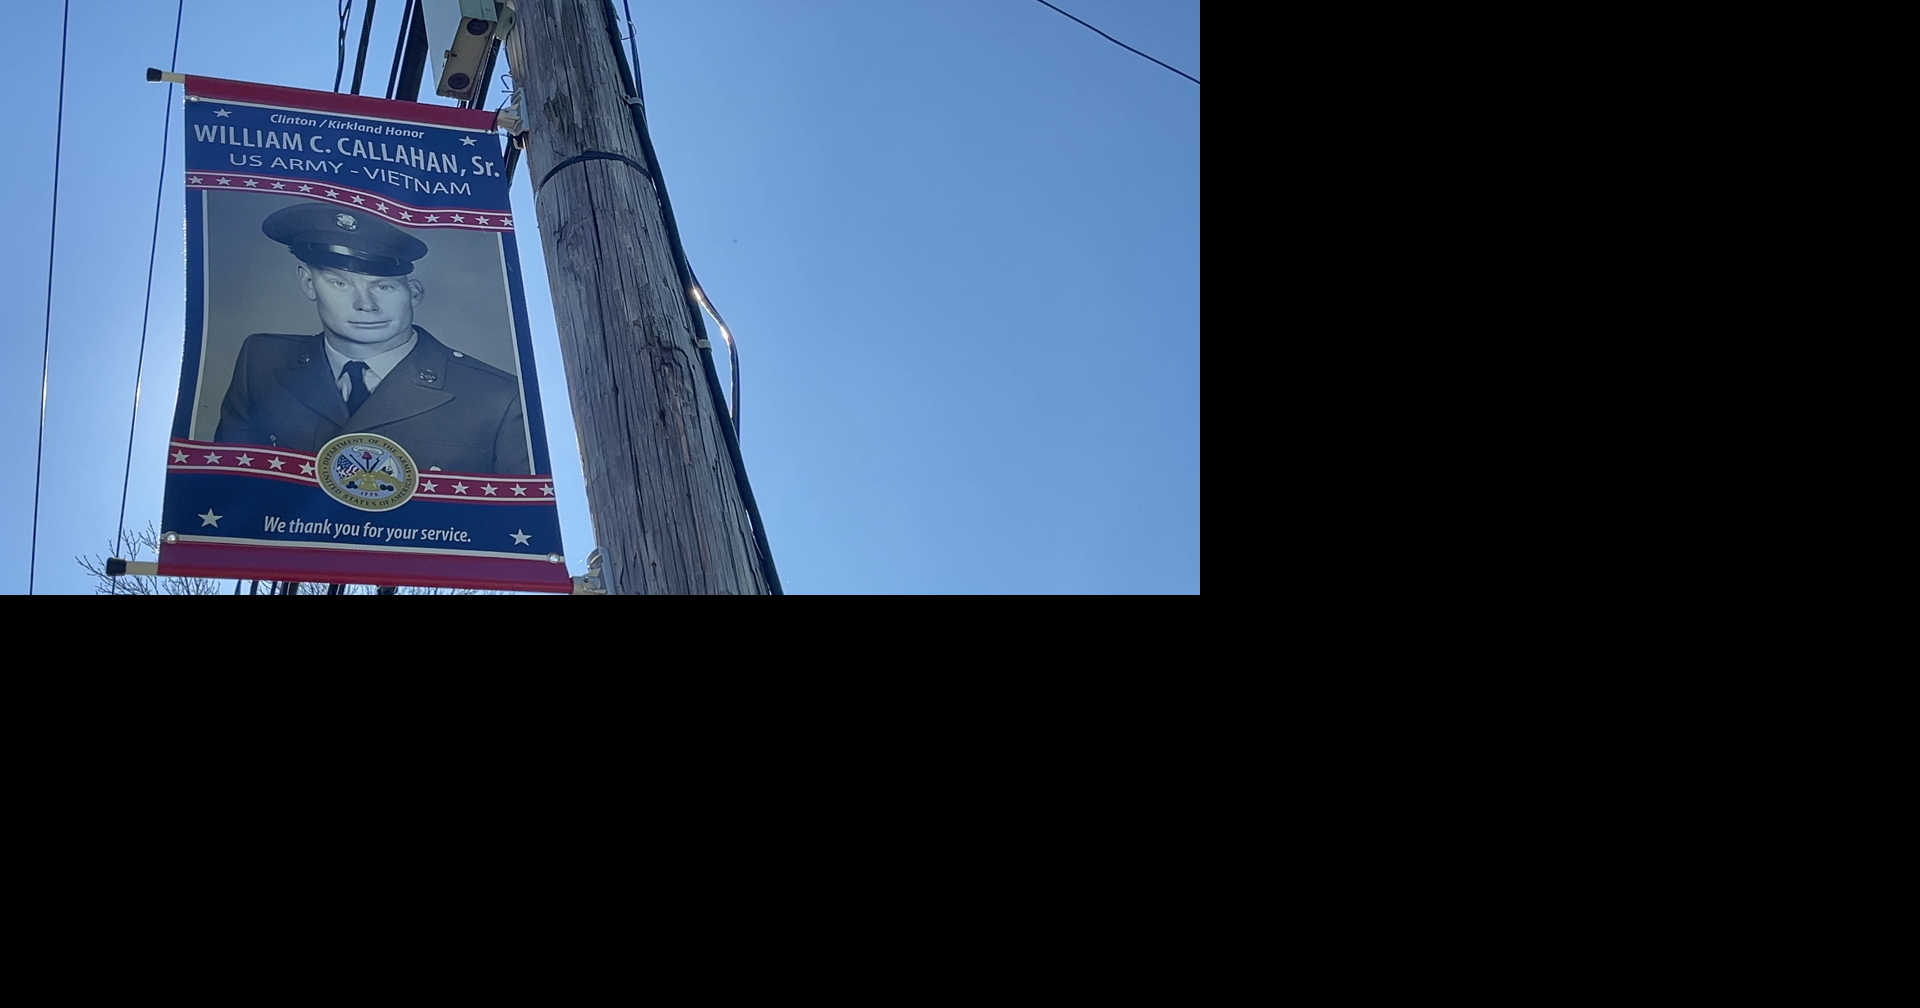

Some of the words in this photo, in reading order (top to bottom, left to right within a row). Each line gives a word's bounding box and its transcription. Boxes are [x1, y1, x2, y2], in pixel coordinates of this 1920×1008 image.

[270, 114, 316, 127] Clinton
[385, 126, 425, 139] Honor
[194, 124, 303, 152] WILLIAM
[309, 135, 332, 154] C.
[337, 137, 467, 177] CALLAHAN,
[471, 155, 500, 178] Sr.
[229, 153, 263, 167] US
[270, 157, 344, 174] ARMY
[363, 166, 472, 196] VIETNAM
[323, 438, 364, 466] DEPARTMENT
[382, 441, 398, 454] THE
[398, 455, 412, 475] ARMY
[323, 471, 342, 495] UNITED
[343, 493, 377, 507] STATES
[379, 499, 389, 507] OF
[390, 477, 412, 504] AMERICA
[264, 516, 285, 533] We
[289, 518, 331, 535] thank
[333, 523, 360, 539] you
[363, 522, 384, 538] for
[385, 527, 419, 542] your
[420, 527, 472, 543] service.
